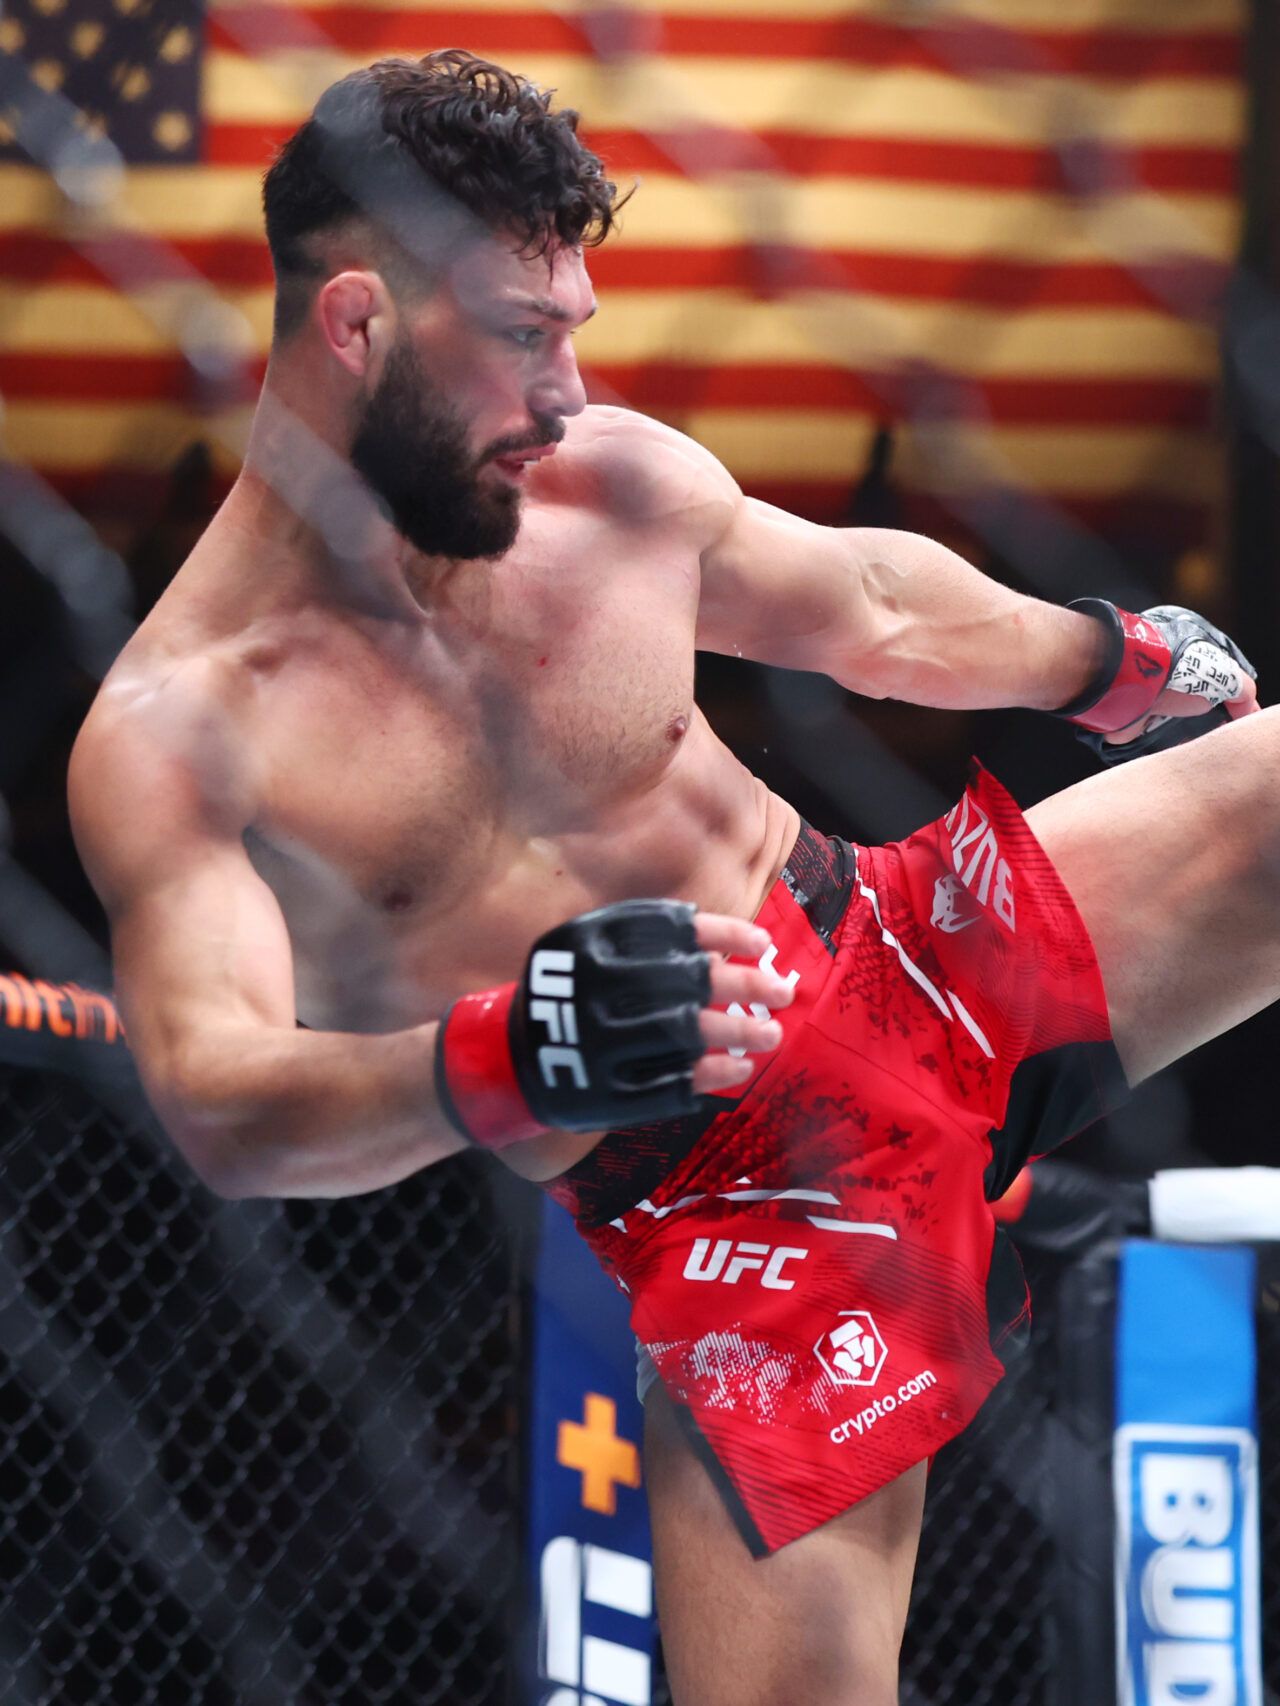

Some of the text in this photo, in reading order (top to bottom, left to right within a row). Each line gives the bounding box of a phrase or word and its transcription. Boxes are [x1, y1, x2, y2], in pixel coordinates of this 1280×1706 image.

[530, 950, 590, 1089] UFC
[683, 1238, 809, 1291] UFC
[830, 1370, 937, 1444] crypto.com
[1140, 1452, 1235, 1706] BUD
